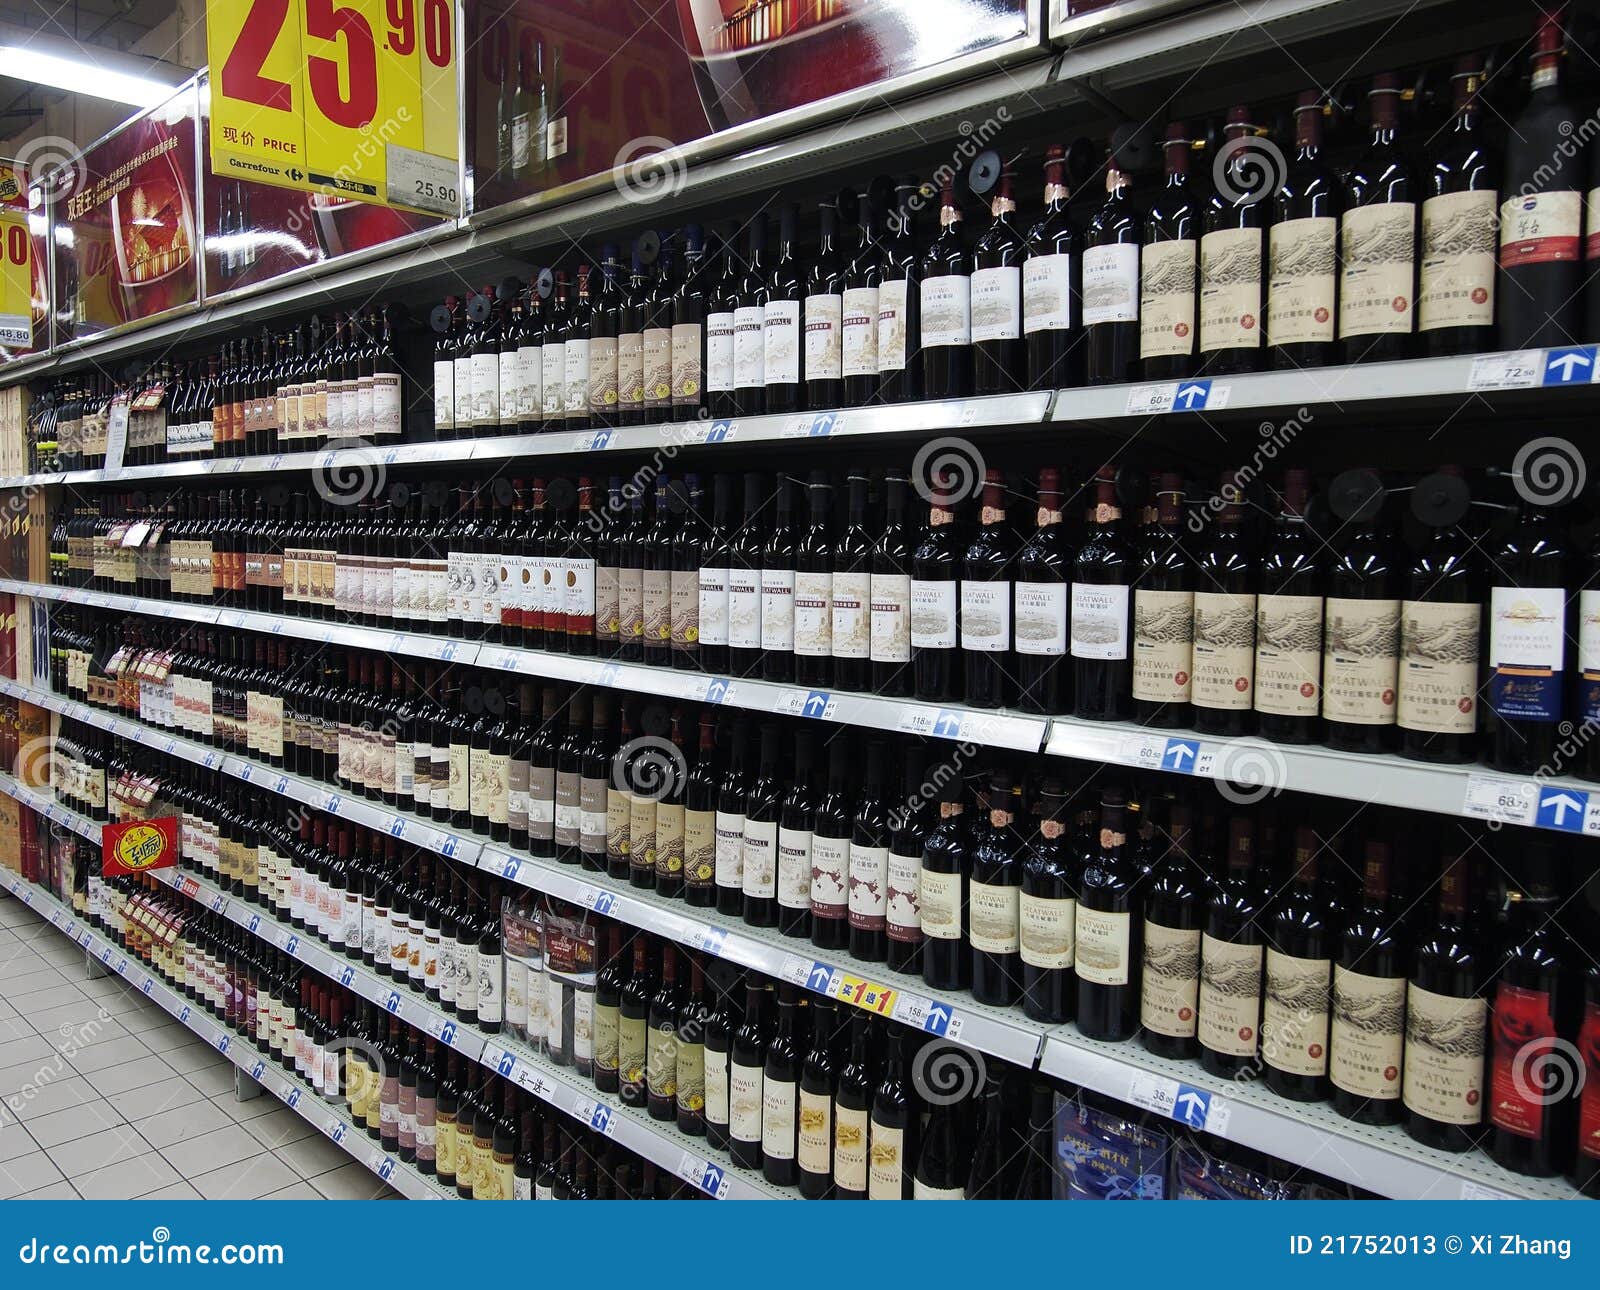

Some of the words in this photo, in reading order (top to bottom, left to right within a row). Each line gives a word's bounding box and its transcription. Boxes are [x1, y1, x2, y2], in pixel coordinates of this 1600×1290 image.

[223, 126, 255, 147] 现价
[263, 137, 297, 154] PRICE
[229, 157, 280, 176] Carrefour
[415, 180, 457, 203] 25.90
[0, 225, 28, 266] 0
[518, 1071, 550, 1094] 买一送一
